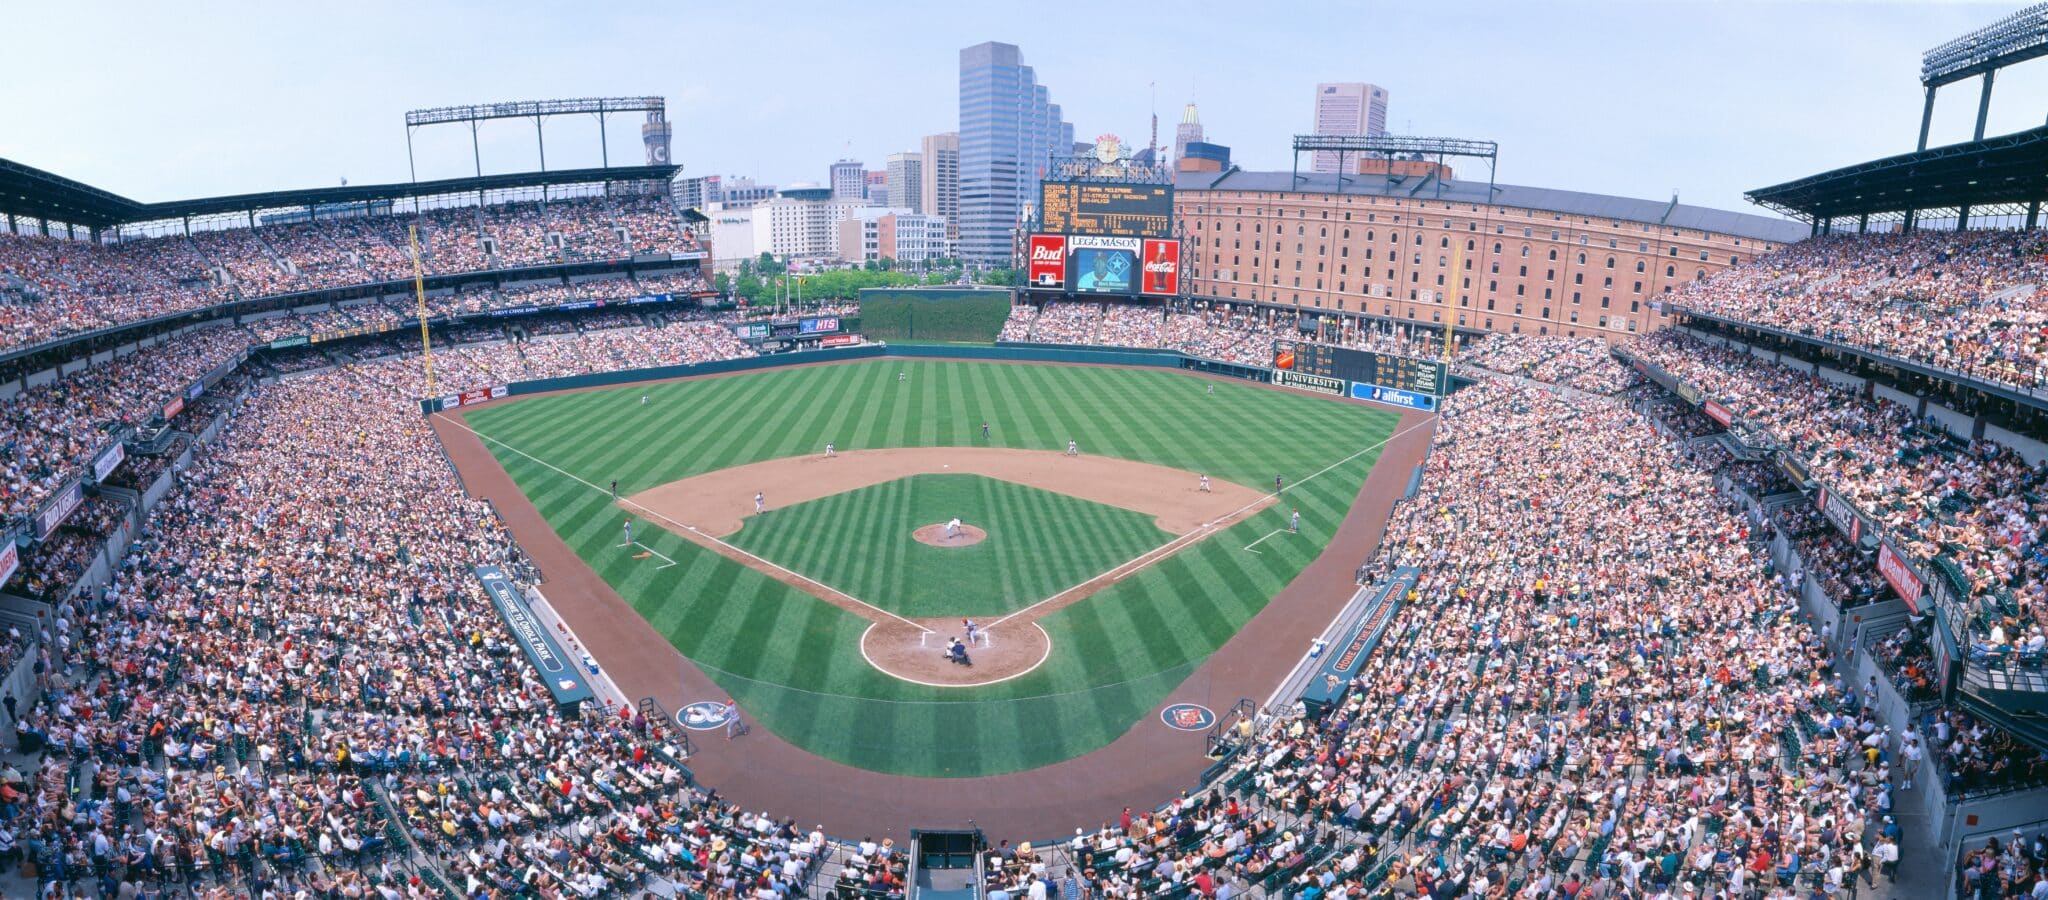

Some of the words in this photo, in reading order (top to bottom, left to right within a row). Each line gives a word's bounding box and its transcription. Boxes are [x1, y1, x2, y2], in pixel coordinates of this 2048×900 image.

[1060, 163, 1088, 176] THE
[1128, 166, 1153, 177] SUN
[1072, 237, 1098, 246] LEGG
[1101, 238, 1136, 248] MASON
[1032, 246, 1064, 260] Bud
[1146, 261, 1176, 272] Coca-Cola
[816, 319, 835, 330] HTS
[1285, 372, 1339, 388] UNIVERSITY
[1383, 388, 1414, 405] allfirst
[45, 506, 59, 531] BUD
[59, 489, 75, 517] LIGHT
[1827, 495, 1852, 528] ADVANCE
[499, 589, 520, 613] WELCOME
[514, 612, 523, 621] TO
[520, 620, 538, 642] ORIOLE
[534, 641, 552, 660] PARK
[1336, 651, 1356, 670] HOME
[1352, 641, 1361, 650] OF
[1358, 628, 1371, 641] THE
[1365, 602, 1389, 630] BALTIMORE
